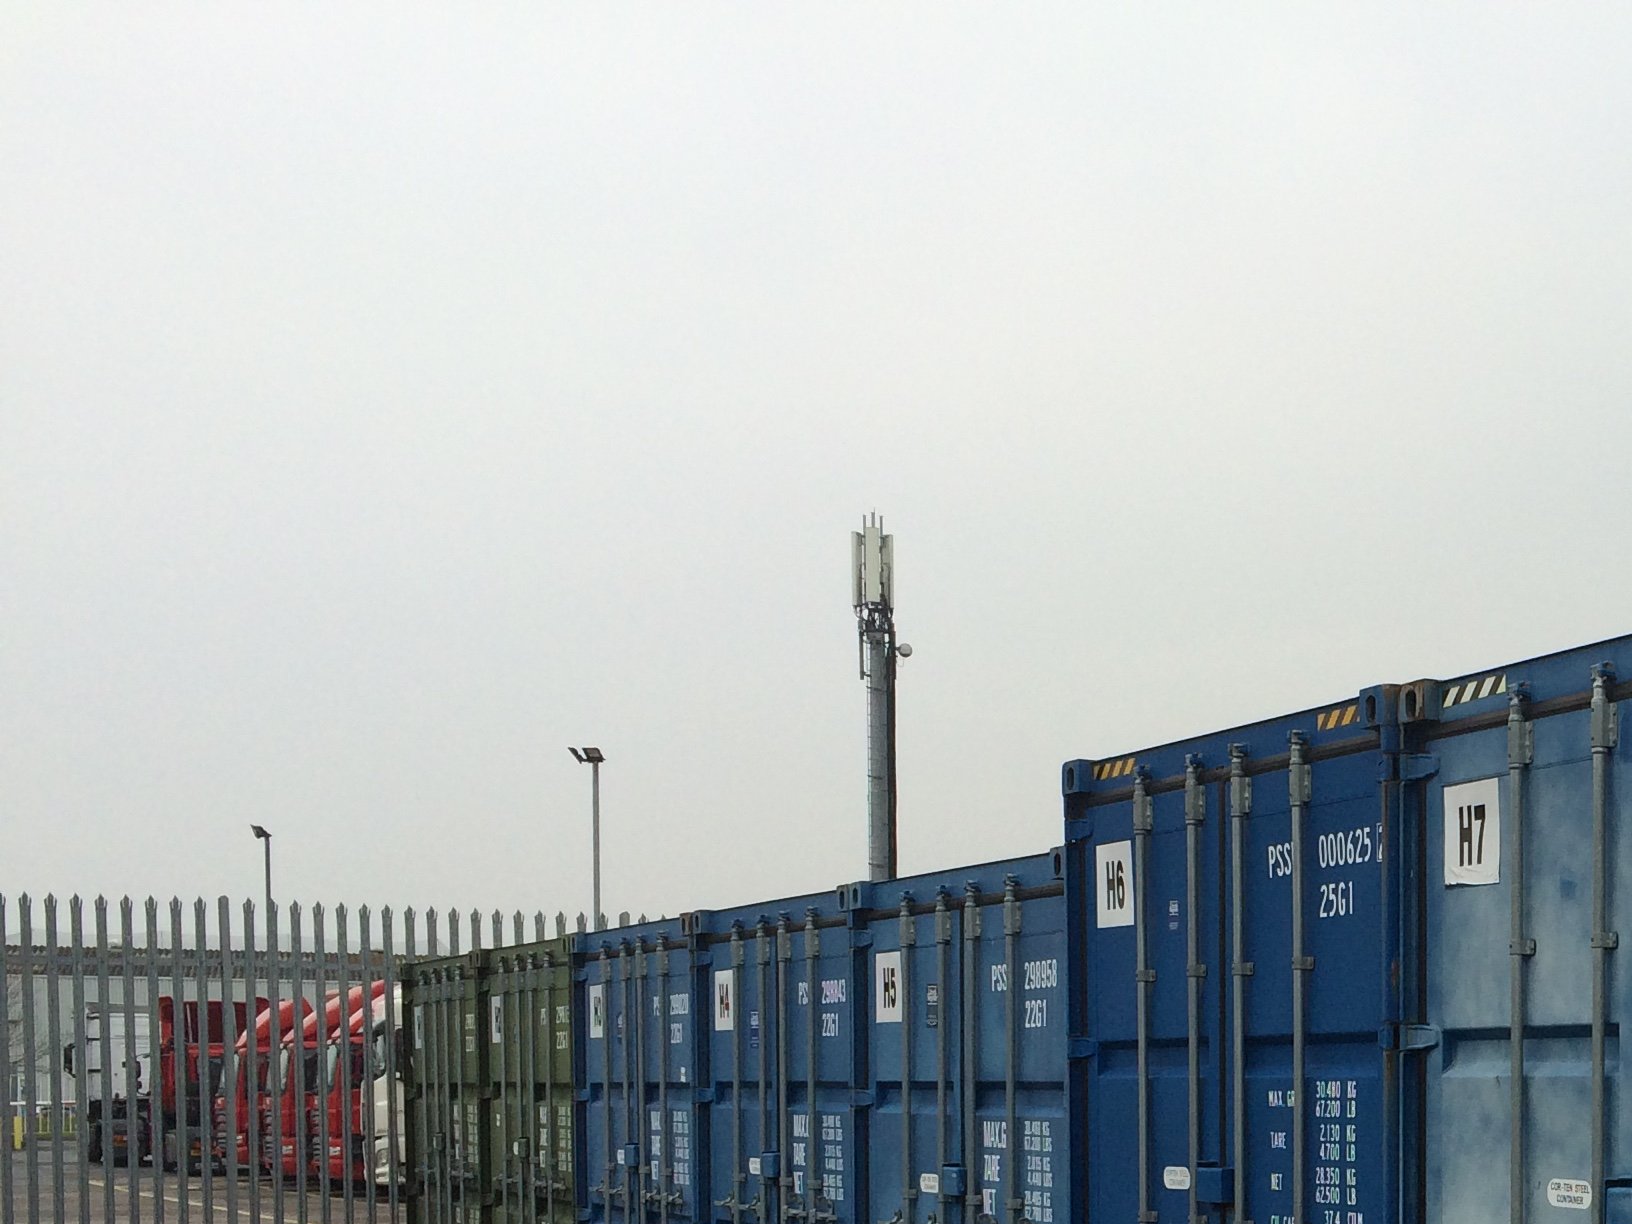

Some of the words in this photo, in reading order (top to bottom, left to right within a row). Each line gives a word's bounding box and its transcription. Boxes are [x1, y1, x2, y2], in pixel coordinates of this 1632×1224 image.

[1459, 804, 1486, 867] H7
[1268, 842, 1294, 878] PSS
[1319, 827, 1371, 868] 000625
[1106, 860, 1125, 911] H6
[1320, 881, 1353, 918] 25G1
[883, 968, 897, 1008] H5
[1024, 959, 1057, 990] 298958
[1025, 1000, 1047, 1028] 22G1
[1347, 1081, 1356, 1098] KG
[1347, 1100, 1356, 1118] LB
[1270, 1132, 1286, 1149] TARE
[1346, 1124, 1356, 1142] KG
[1347, 1144, 1356, 1161] LB
[984, 1154, 1000, 1182] TARE
[1271, 1173, 1282, 1190] NET
[1346, 1168, 1356, 1185] KG
[983, 1188, 996, 1215] NET
[1347, 1187, 1356, 1205] LB
